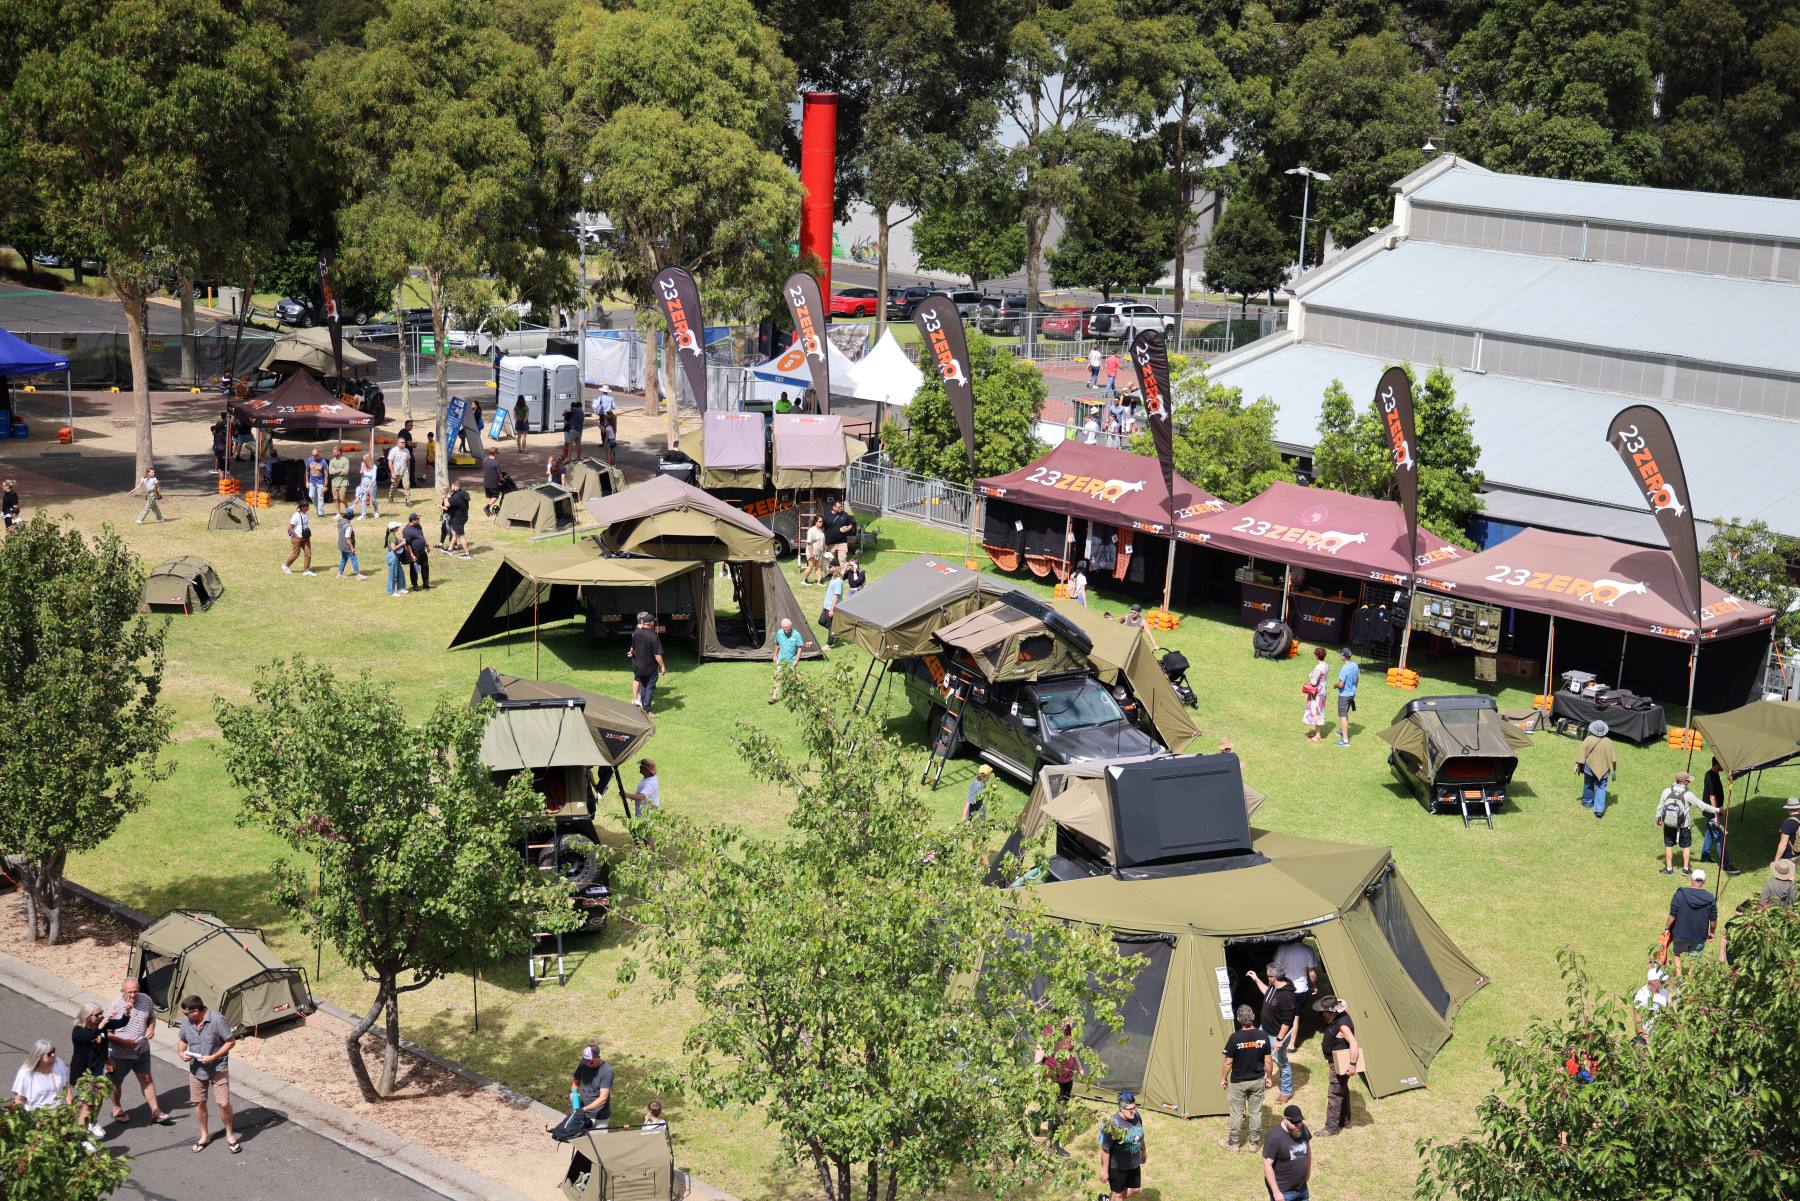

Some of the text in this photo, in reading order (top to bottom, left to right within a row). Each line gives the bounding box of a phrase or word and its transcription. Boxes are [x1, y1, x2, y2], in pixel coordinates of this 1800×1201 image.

[660, 278, 692, 347] 23ZERO
[789, 285, 818, 352] 23ZERO
[921, 308, 957, 378] 23ZERO
[1136, 342, 1160, 412] 23ZERO
[1381, 385, 1407, 463] 23ZERO
[1025, 466, 1123, 499] 23ZERO
[1618, 424, 1671, 507] 23ZERO
[1232, 516, 1344, 549] 23ZERO
[1485, 565, 1619, 602] 23ZERO
[1650, 625, 1688, 638] 23ZERO
